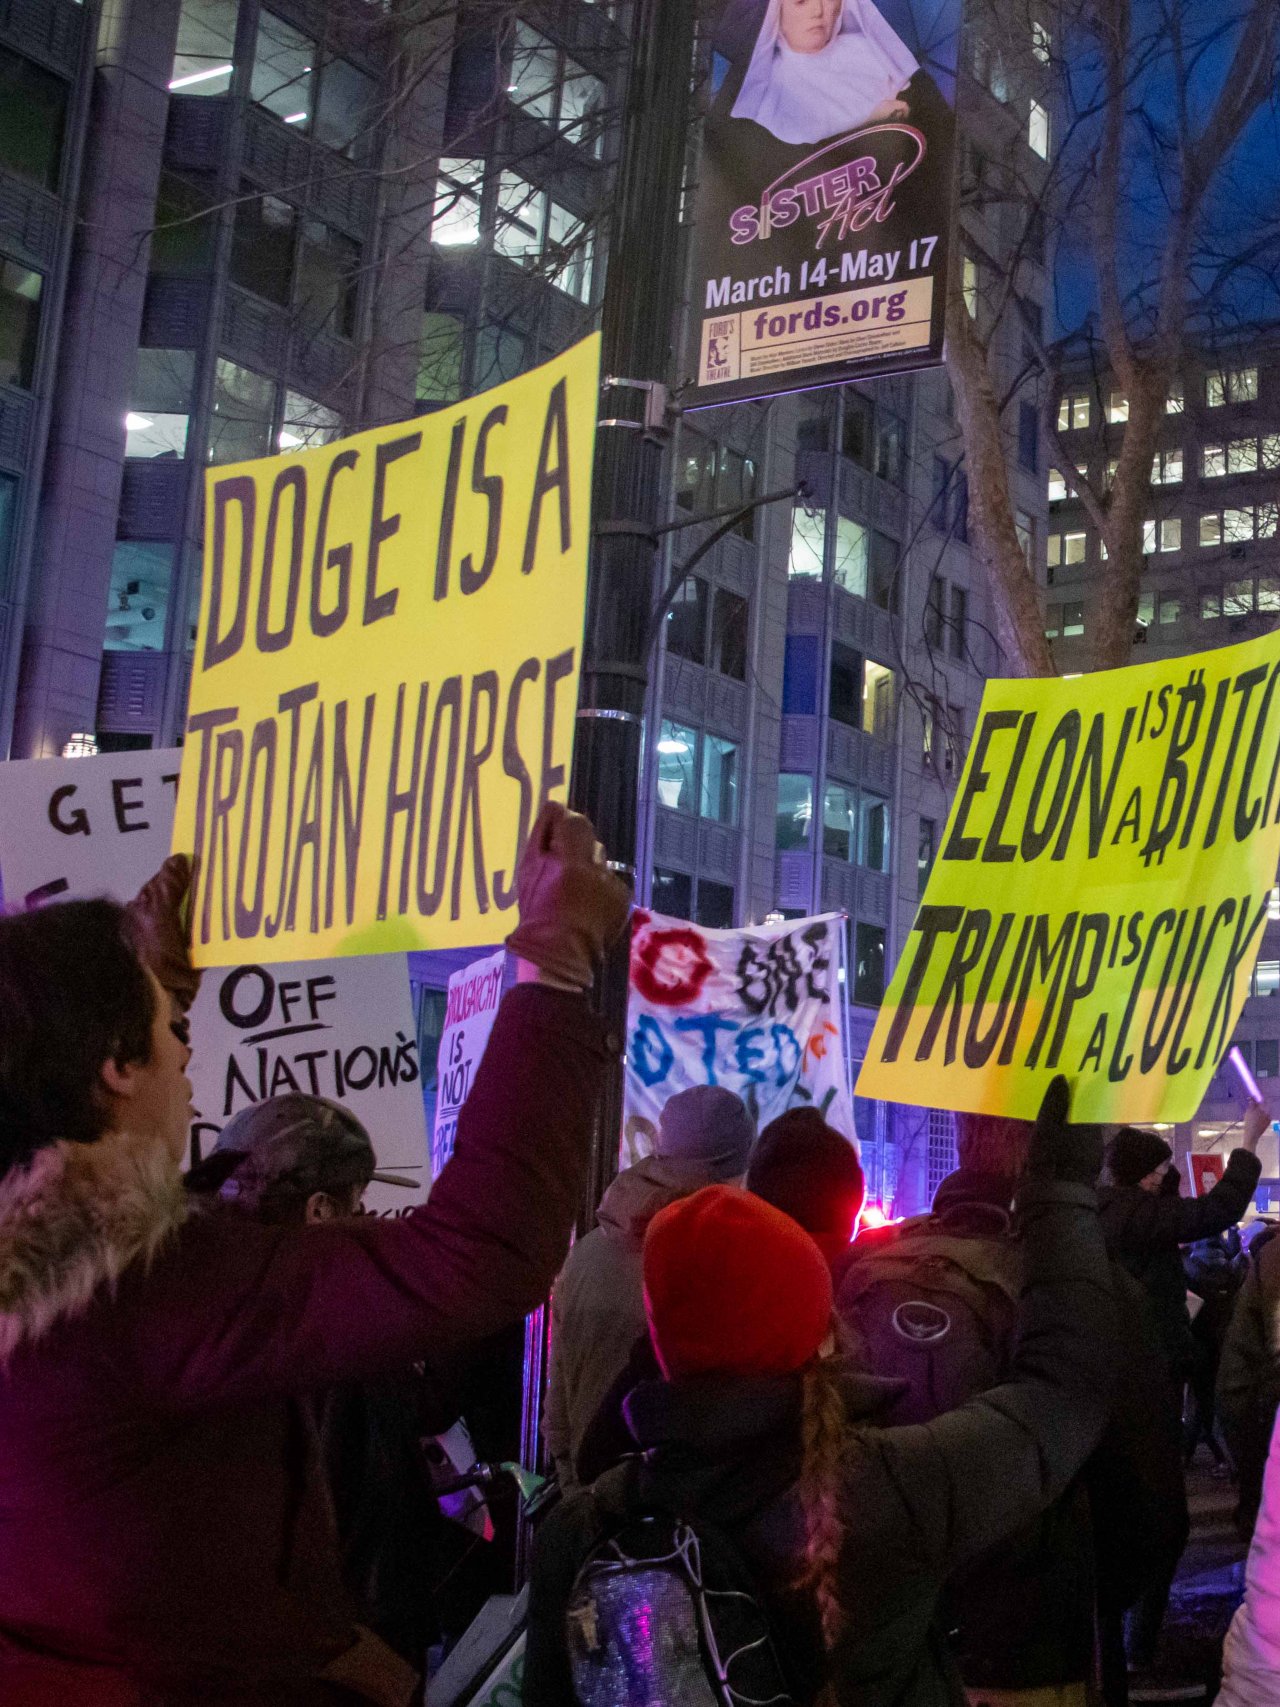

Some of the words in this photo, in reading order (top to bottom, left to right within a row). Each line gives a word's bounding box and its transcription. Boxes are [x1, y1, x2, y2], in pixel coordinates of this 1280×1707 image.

[729, 156, 881, 246] SISTER
[816, 162, 904, 250] Act
[705, 265, 790, 310] March
[800, 249, 901, 291] 14-May
[908, 235, 939, 270] 17
[708, 319, 735, 338] FORD'S
[754, 290, 908, 341] fords.org
[706, 364, 732, 382] THEATRE
[202, 430, 423, 672] DOGE
[433, 404, 509, 602] IS
[521, 376, 571, 575] A
[1136, 684, 1174, 744] IS
[187, 680, 377, 946] TROJAN
[376, 646, 576, 922] HORSE
[942, 707, 1138, 863] ELON
[1111, 786, 1141, 846] A
[1107, 912, 1143, 970] IS
[219, 964, 336, 1029] OFF
[880, 904, 1110, 1071] TRUMP
[1107, 890, 1272, 1083] CUCK
[449, 1030, 465, 1067] IS
[1079, 1012, 1111, 1073] A
[441, 1058, 473, 1107] NOT
